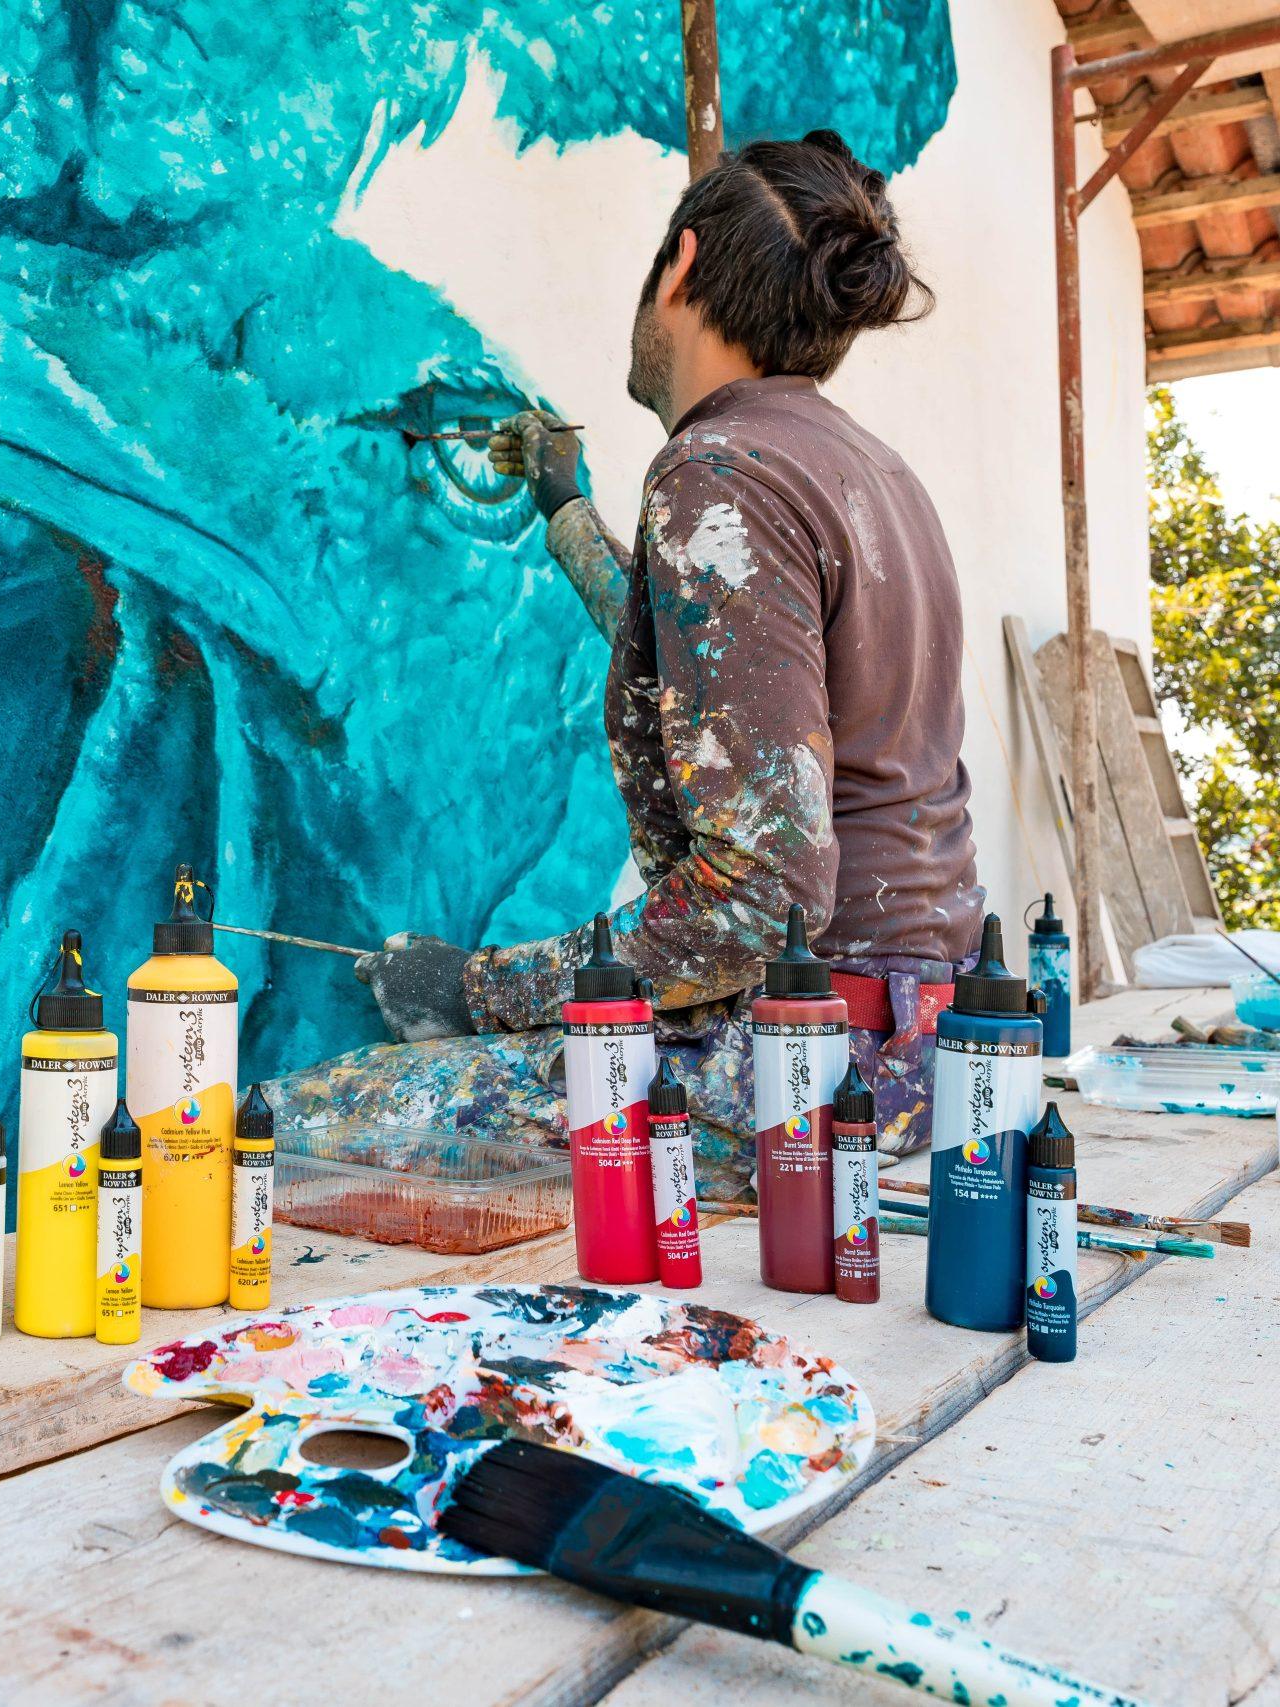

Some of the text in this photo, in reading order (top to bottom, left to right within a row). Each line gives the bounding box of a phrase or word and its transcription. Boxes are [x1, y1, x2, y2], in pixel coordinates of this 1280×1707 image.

[146, 992, 228, 1002] DALER ROWNEY
[570, 1024, 648, 1035] DALER ROWNEY
[755, 1024, 838, 1034] DALER ROWNEY
[938, 1036, 1028, 1055] DALER ROWNEY
[31, 1059, 114, 1070] DALER ROWNEY
[655, 1123, 678, 1131] DALER
[655, 1129, 687, 1138] ROWNEY
[838, 1135, 863, 1144] DALER
[838, 1143, 873, 1151] ROWNEY
[163, 1153, 180, 1162] 620
[242, 1152, 266, 1160] DALER
[242, 1159, 273, 1167] ROWNEY
[598, 1159, 613, 1167] 504
[779, 1163, 794, 1172] 221
[103, 1172, 128, 1180] DALER
[103, 1179, 137, 1187] ROWNEY
[1029, 1179, 1054, 1190] DALER
[953, 1188, 970, 1199] 154
[1029, 1188, 1065, 1200] ROWNEY
[53, 1204, 68, 1212] 651
[667, 1252, 681, 1260] 504
[840, 1268, 853, 1278] 221
[237, 1278, 251, 1286] 620
[101, 1309, 115, 1317] 651
[1028, 1321, 1040, 1332] 154
